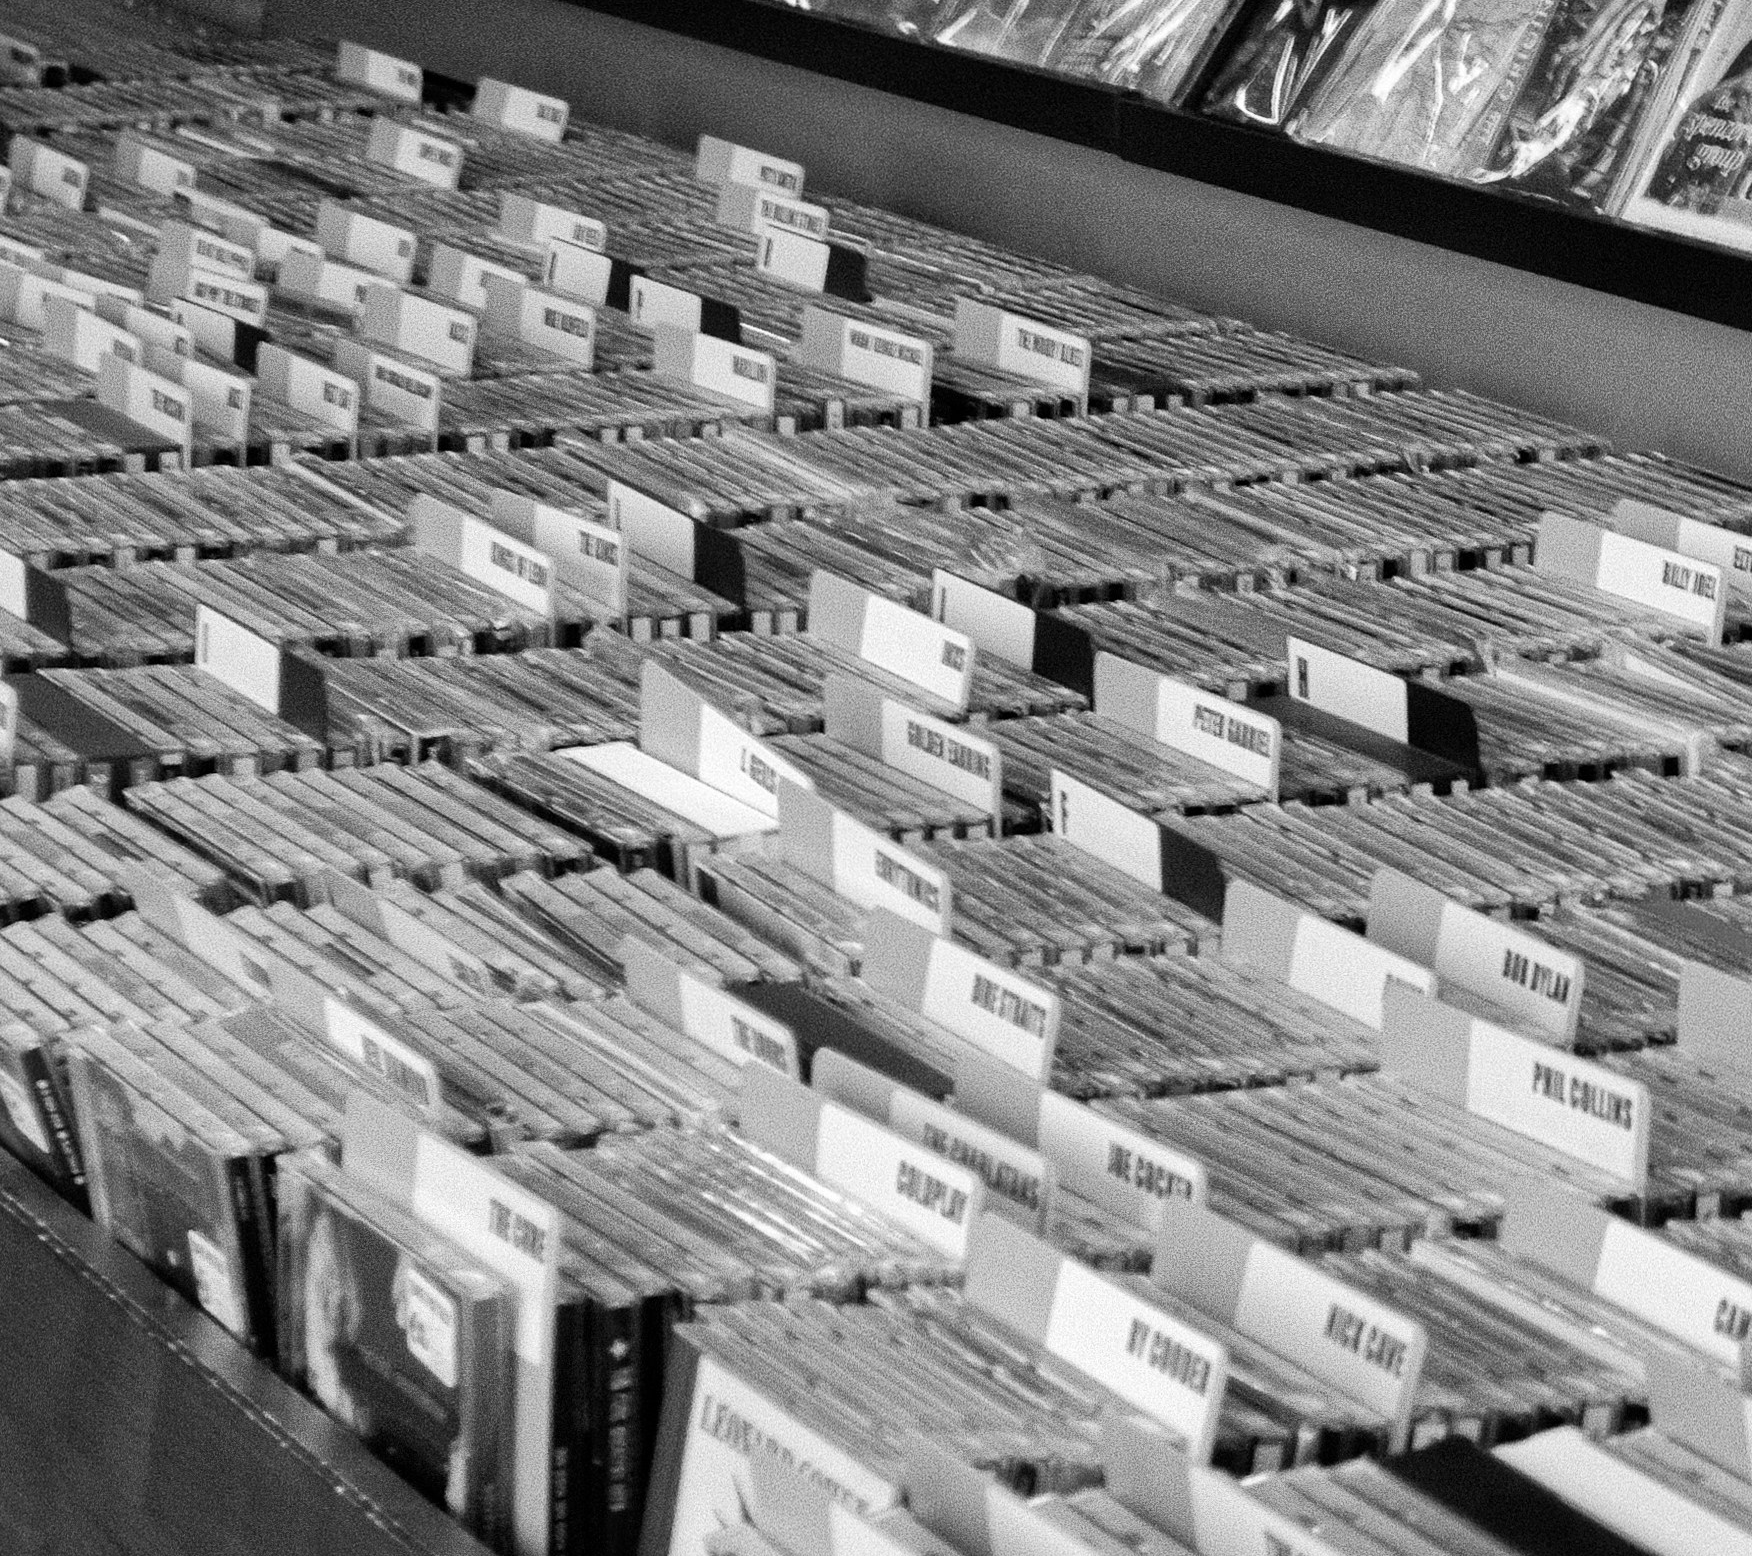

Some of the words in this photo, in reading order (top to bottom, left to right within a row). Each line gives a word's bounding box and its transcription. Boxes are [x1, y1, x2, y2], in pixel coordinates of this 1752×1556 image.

[1533, 1061, 1566, 1105] PHIL
[1567, 1075, 1633, 1132] COLLINS
[1323, 1302, 1364, 1356] NICK
[1365, 1323, 1408, 1380] CAVE
